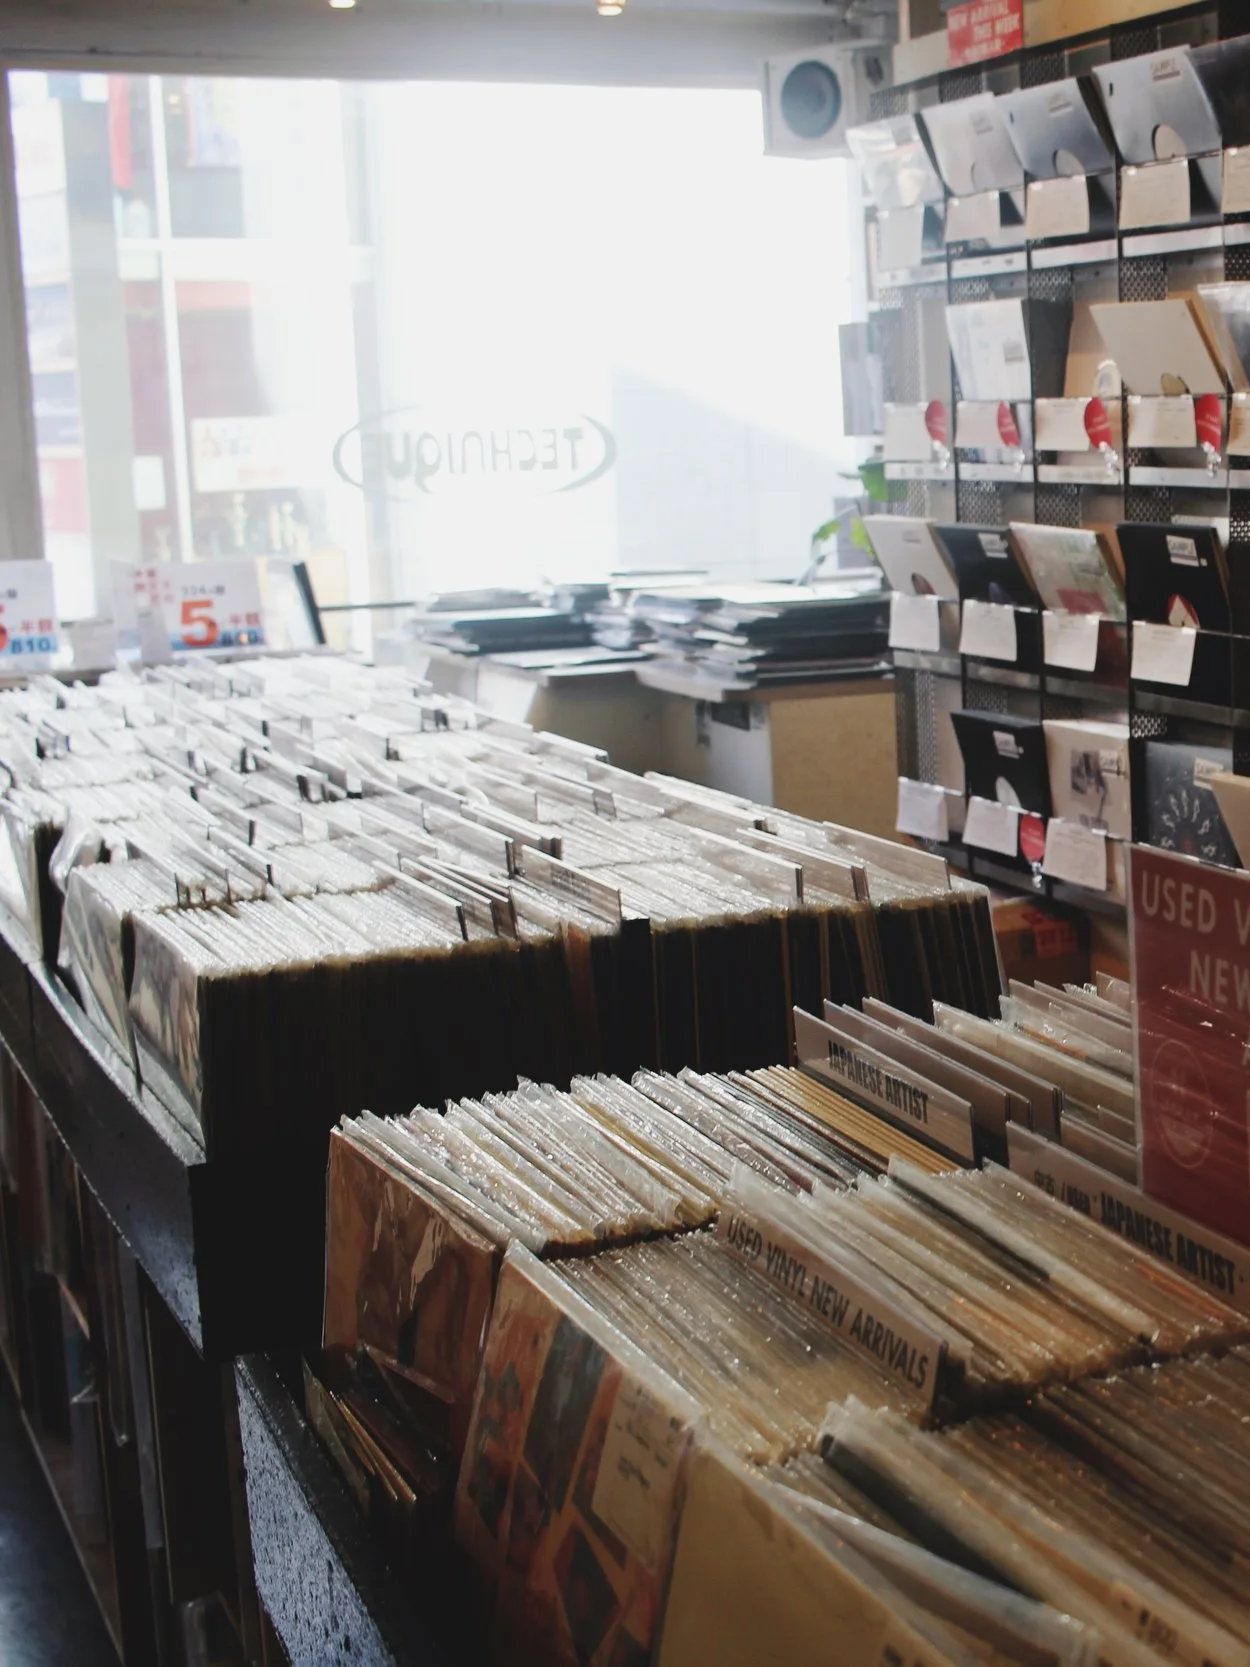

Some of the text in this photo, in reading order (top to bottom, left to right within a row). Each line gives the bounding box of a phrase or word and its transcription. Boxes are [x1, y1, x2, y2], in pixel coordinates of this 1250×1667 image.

[180, 600, 220, 647] 5
[1140, 870, 1217, 933] USED
[828, 1040, 929, 1125] JAPANESE ARTIST
[1100, 1191, 1174, 1263] JAPANESE
[1176, 1232, 1237, 1295] ARTIST
[727, 1213, 930, 1391] USED VINYL NEW ARRIVALS
